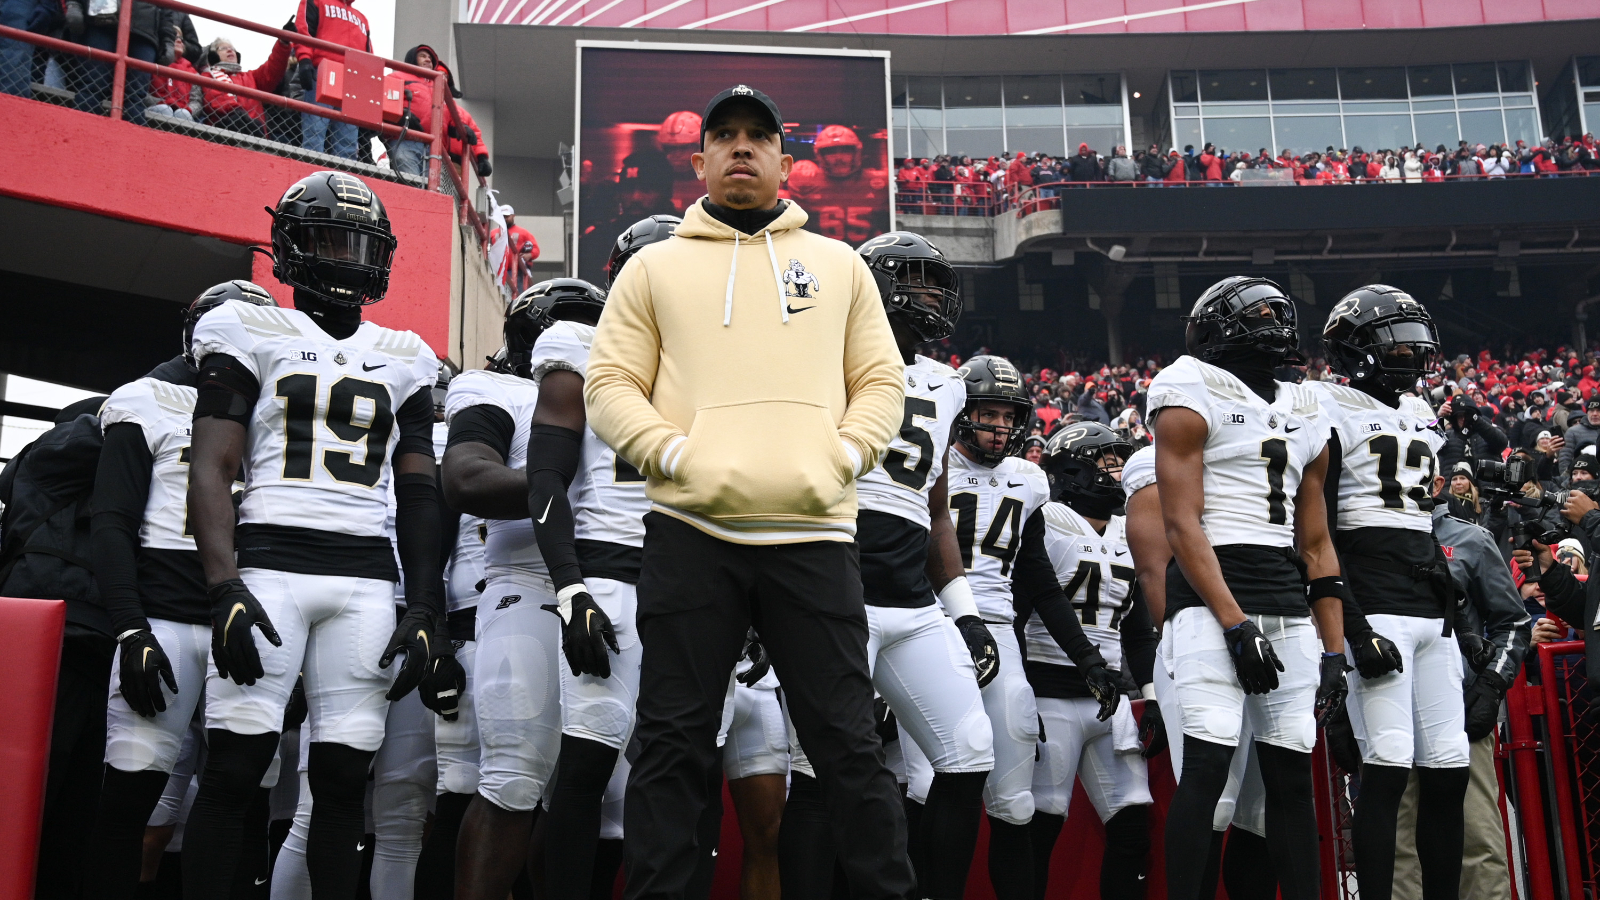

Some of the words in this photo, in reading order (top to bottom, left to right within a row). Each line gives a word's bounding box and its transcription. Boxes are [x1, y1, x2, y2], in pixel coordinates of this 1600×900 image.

[325, 4, 368, 36] NEBRASKA
[272, 371, 396, 490] 19
[1259, 436, 1290, 526] 1
[949, 490, 1025, 579] 14
[1062, 558, 1136, 632] 47
